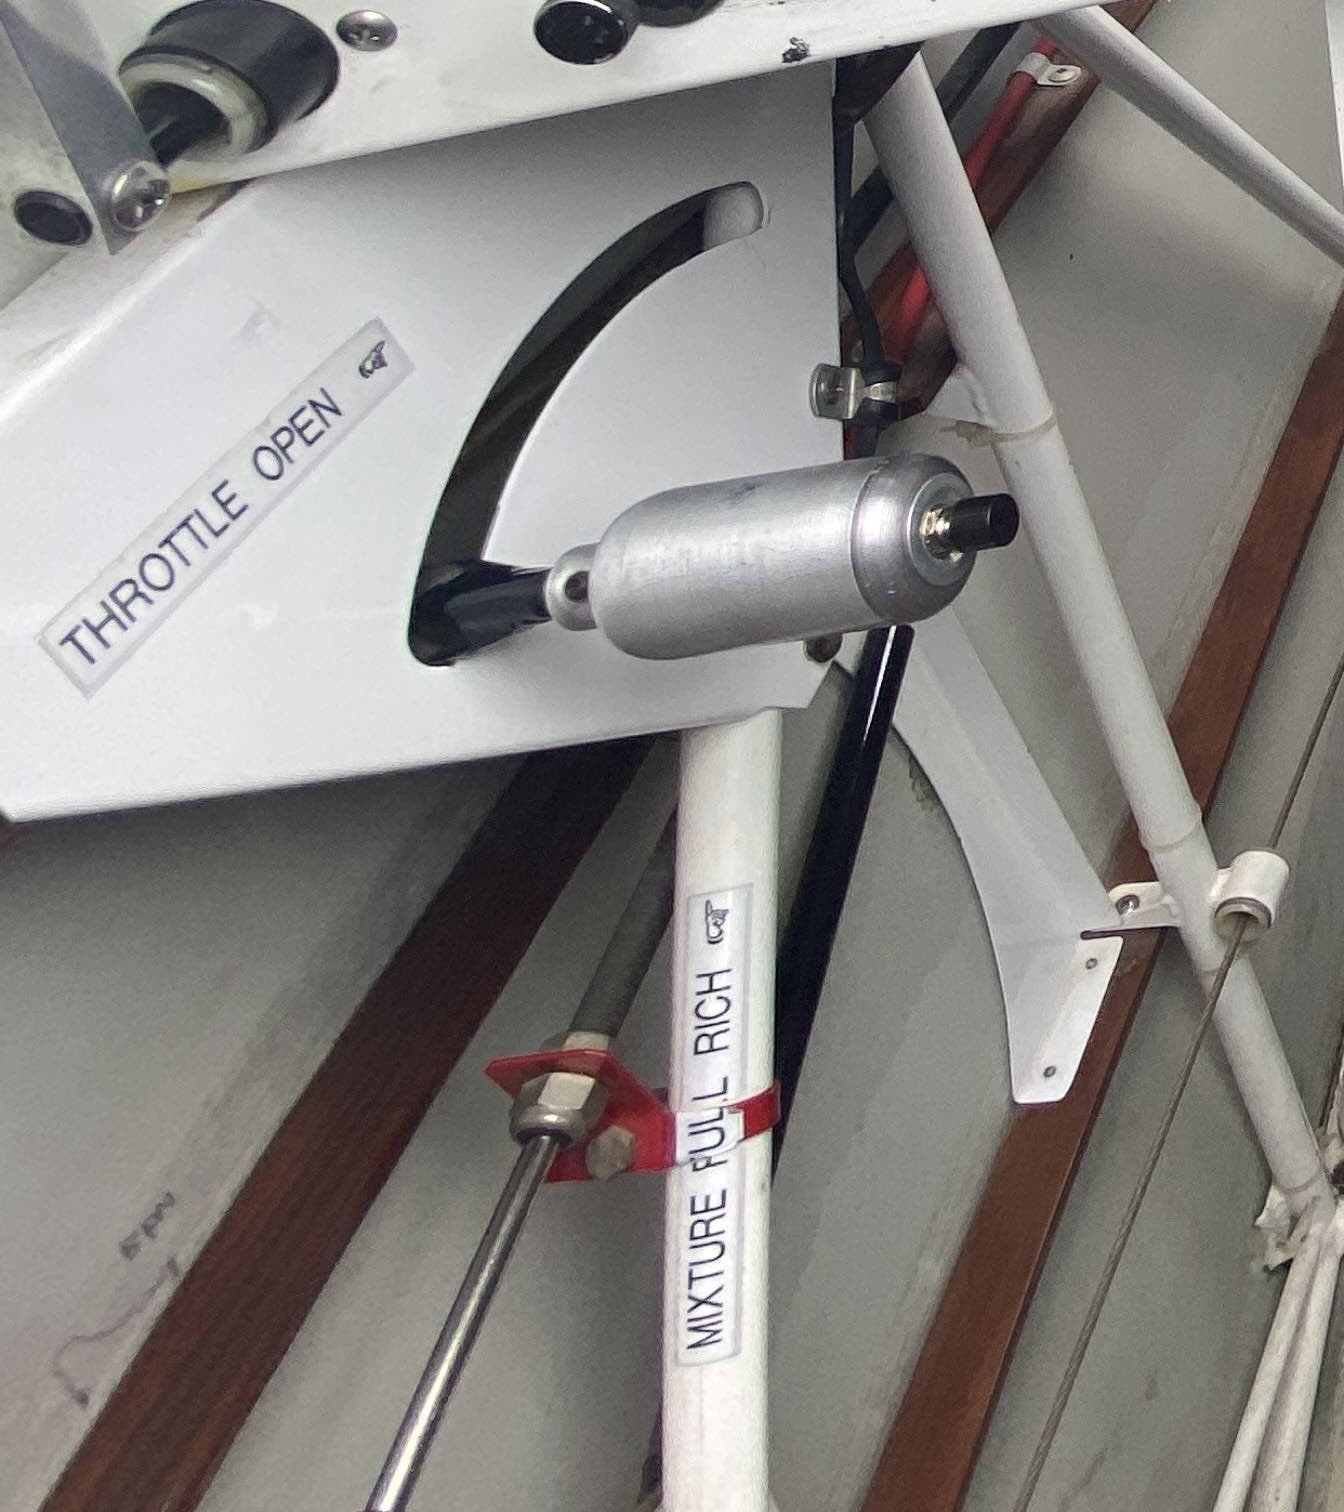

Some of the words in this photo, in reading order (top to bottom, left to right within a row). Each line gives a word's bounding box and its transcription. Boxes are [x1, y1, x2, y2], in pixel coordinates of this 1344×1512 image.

[59, 479, 249, 665] THROTTLE
[252, 387, 343, 482] OPEN
[693, 967, 733, 1056] RICH
[688, 1076, 728, 1173] FULL
[687, 1188, 728, 1352] MIXTURE
